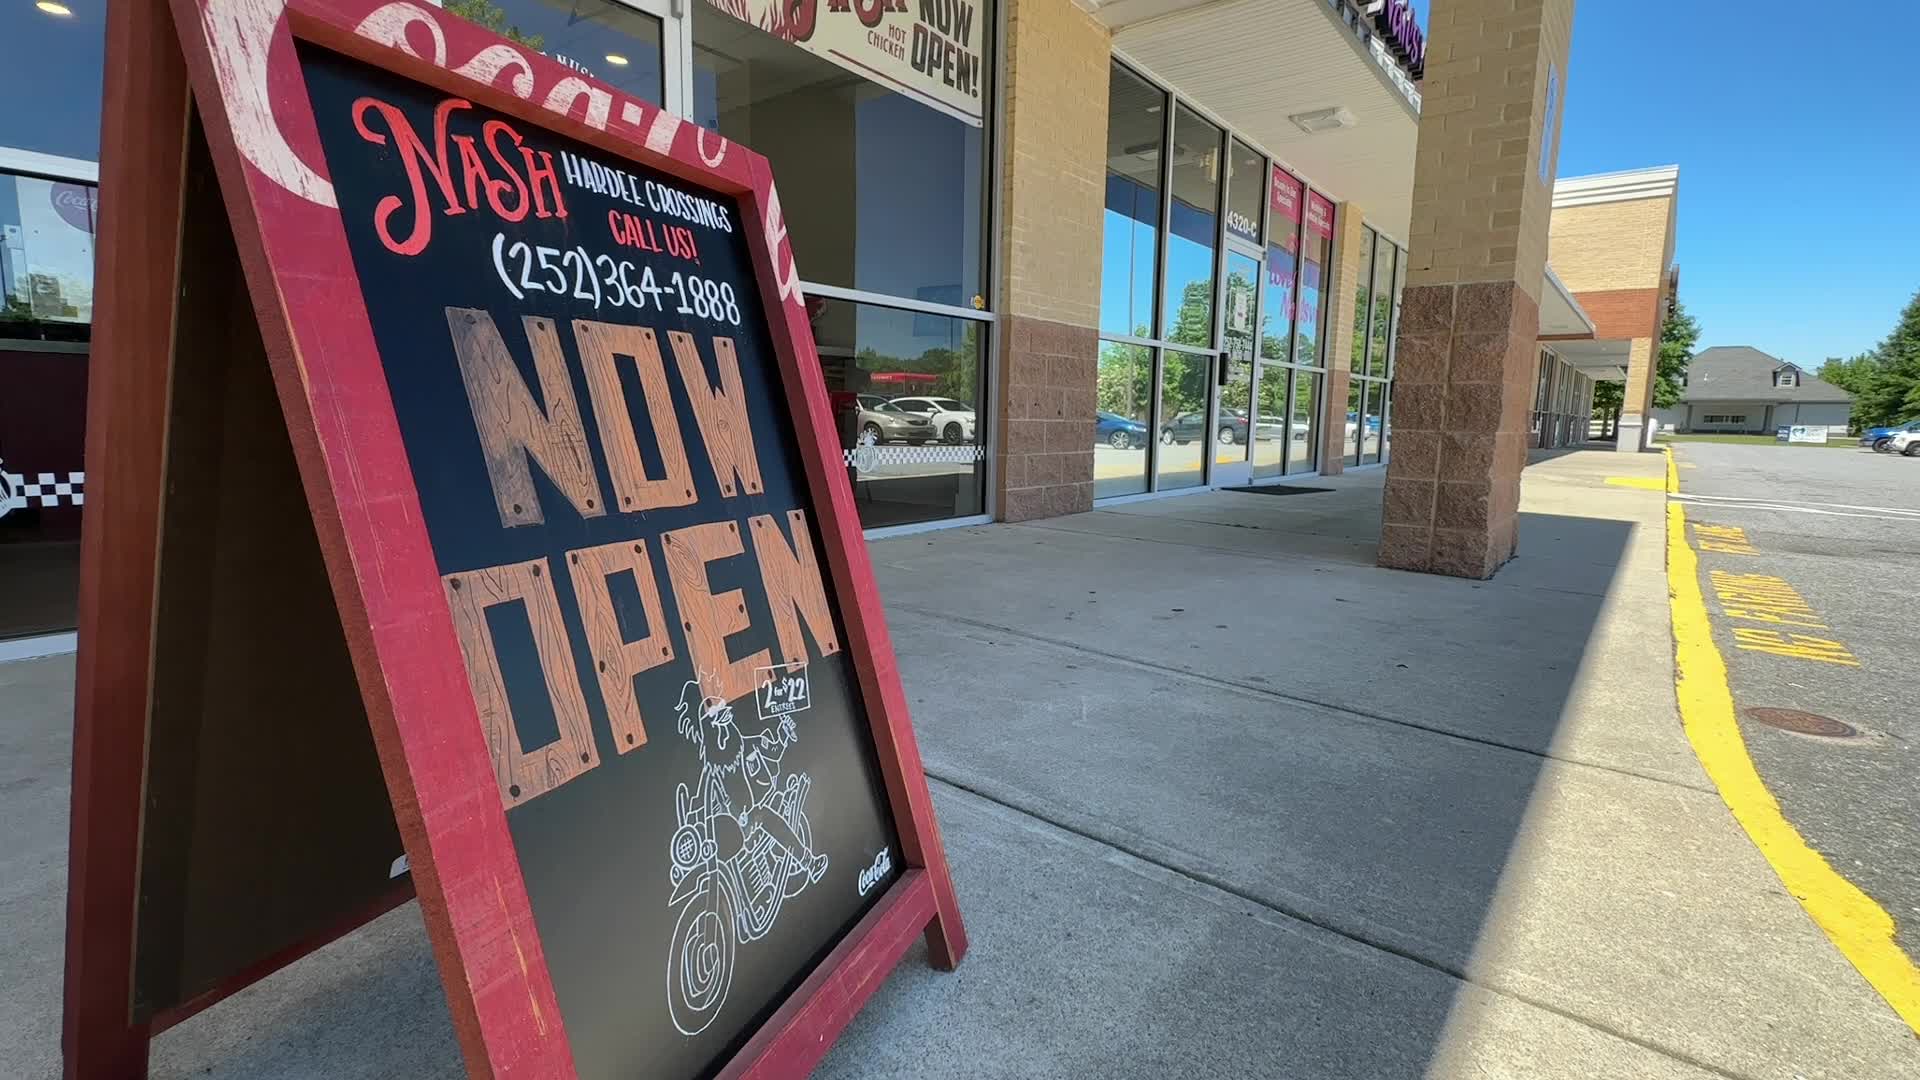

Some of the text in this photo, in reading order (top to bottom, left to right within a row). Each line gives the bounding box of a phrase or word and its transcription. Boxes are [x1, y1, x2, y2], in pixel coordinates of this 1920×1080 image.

[867, 30, 906, 62] CHICKEN
[888, 24, 907, 43] HOT
[911, 22, 980, 99] OPEN!
[352, 97, 568, 256] NASH
[560, 151, 733, 233] HARDEE CROSSINGS
[607, 209, 701, 266] CALL US!
[1227, 210, 1257, 238] 4320-C
[492, 232, 741, 326] (252)364-1888
[445, 306, 764, 529] NOW
[441, 509, 842, 813] OPEN
[761, 680, 777, 709] 2
[782, 676, 806, 702] $22
